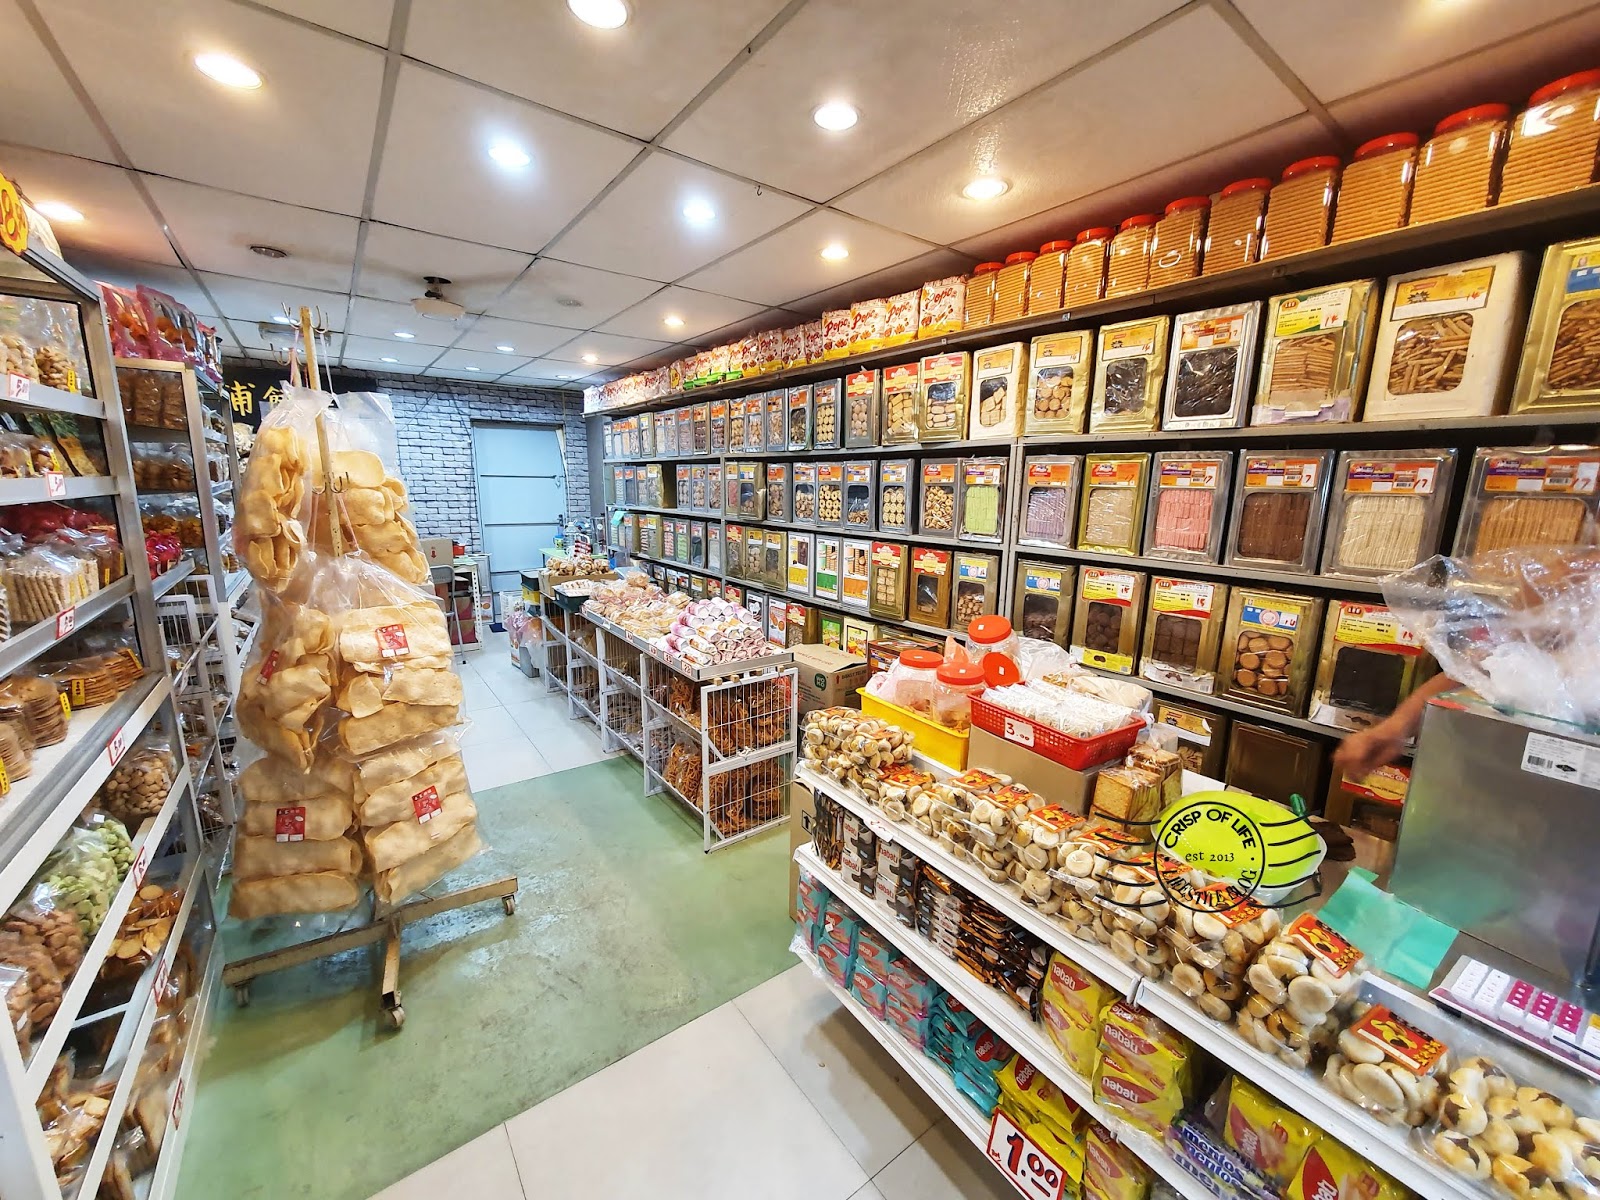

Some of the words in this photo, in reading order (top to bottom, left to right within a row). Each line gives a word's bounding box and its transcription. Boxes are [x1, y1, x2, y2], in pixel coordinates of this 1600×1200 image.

[1006, 722, 1030, 742] 3.00
[1051, 963, 1076, 990] nabati
[1104, 1024, 1138, 1054] nabati
[1102, 1076, 1138, 1103] nabati
[1007, 1132, 1059, 1188] 1.00
[1182, 1125, 1244, 1181] mentos
